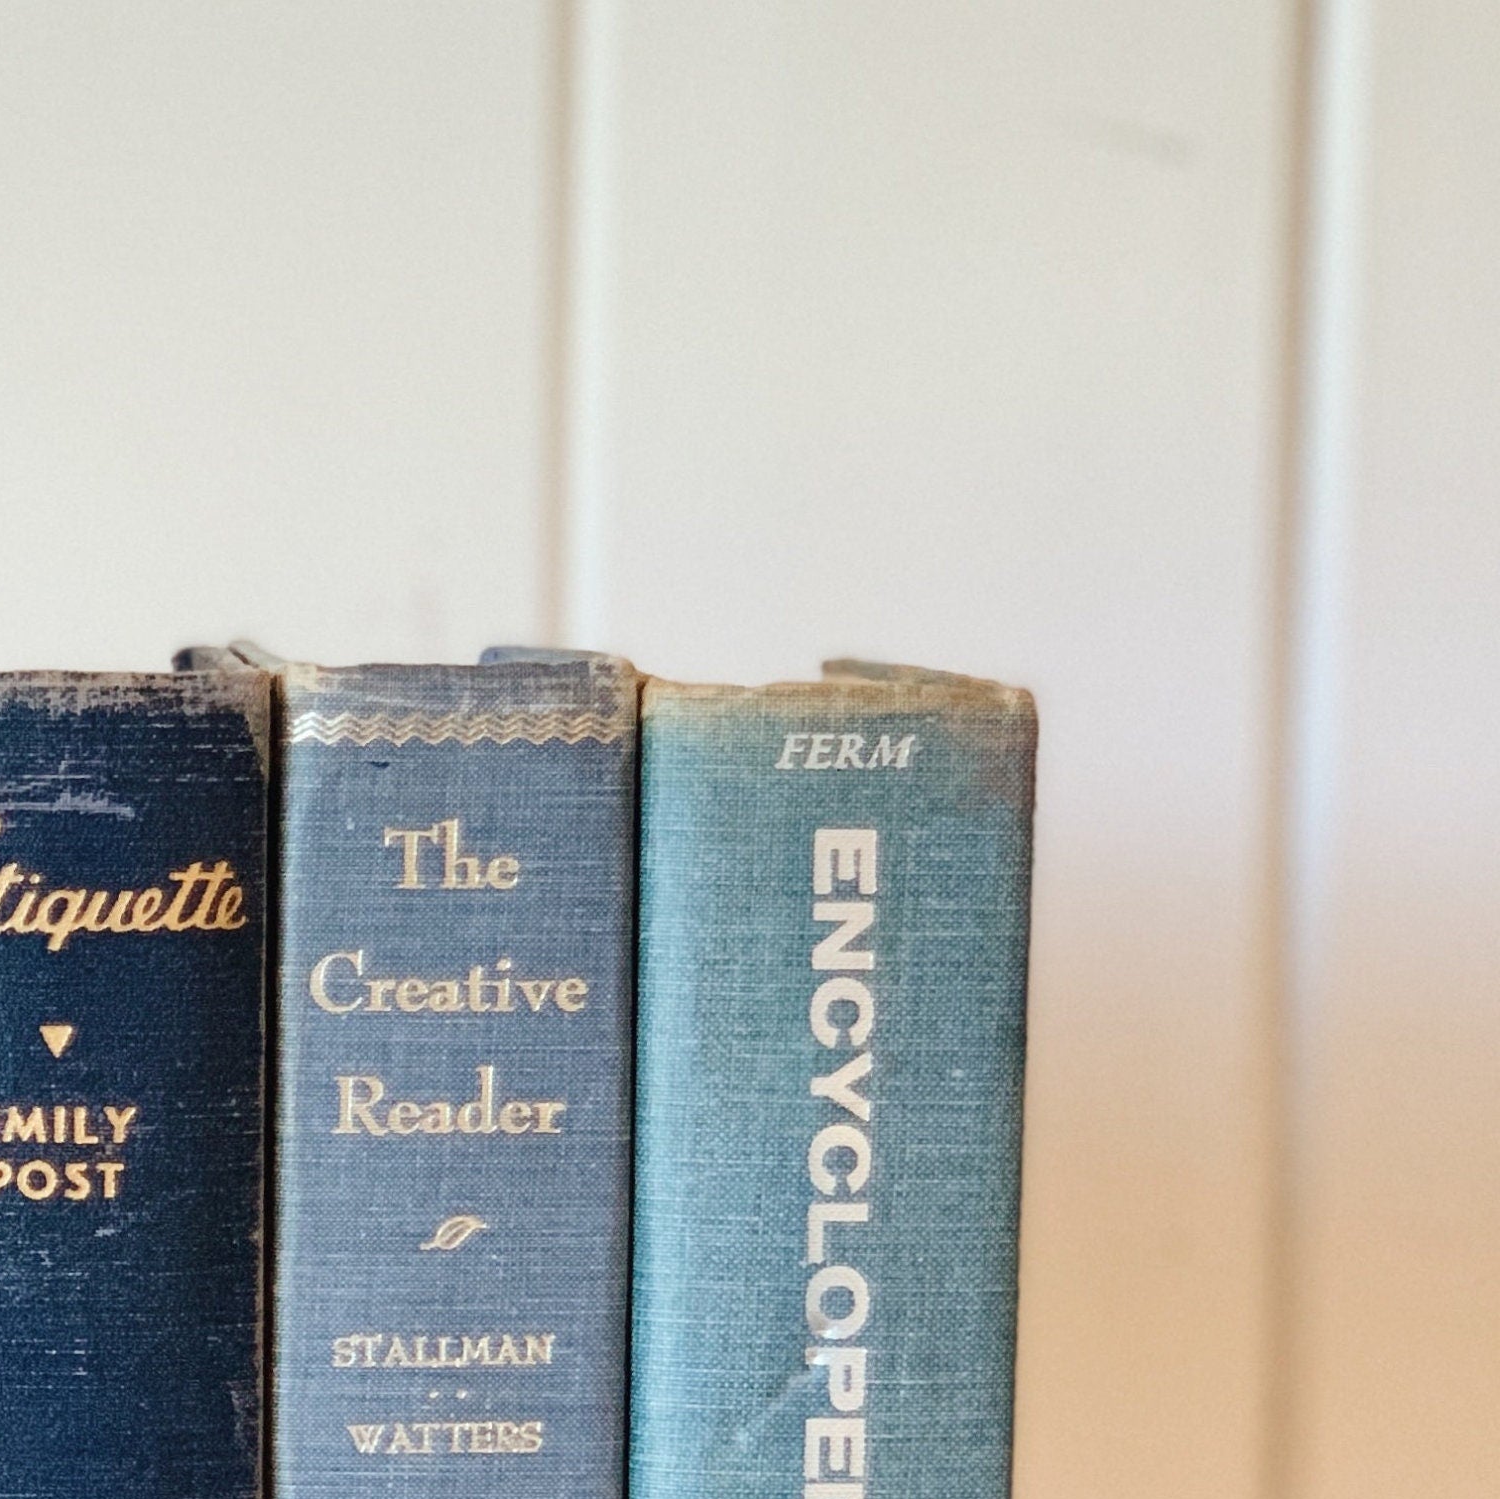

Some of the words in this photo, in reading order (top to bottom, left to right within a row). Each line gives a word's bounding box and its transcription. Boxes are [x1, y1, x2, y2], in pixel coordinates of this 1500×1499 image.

[775, 733, 918, 771] FERM
[384, 819, 520, 892] The
[309, 950, 589, 1014] Creative
[333, 1067, 567, 1137] Reader
[332, 1333, 557, 1369] STALLMAN
[346, 1421, 544, 1455] WATTERS
